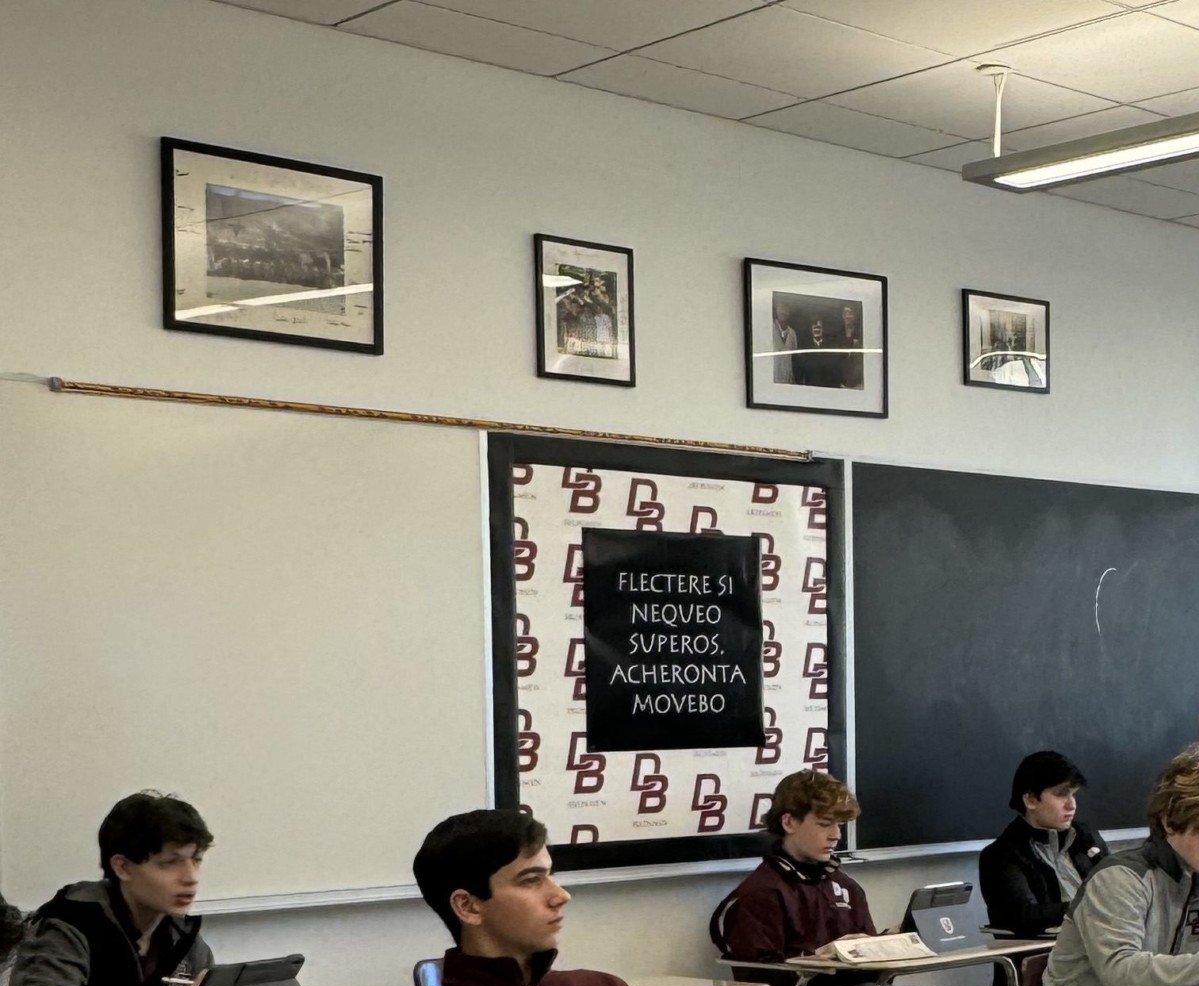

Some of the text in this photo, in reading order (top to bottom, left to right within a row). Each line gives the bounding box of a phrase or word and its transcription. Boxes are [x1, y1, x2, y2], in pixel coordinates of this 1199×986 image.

[618, 572, 734, 597] FLECTERE SI
[631, 603, 722, 627] NEQUEO
[609, 664, 747, 685] ACHERONTA
[632, 693, 726, 715] MOVEBO
[630, 753, 669, 814] DB
[691, 773, 728, 833] DB
